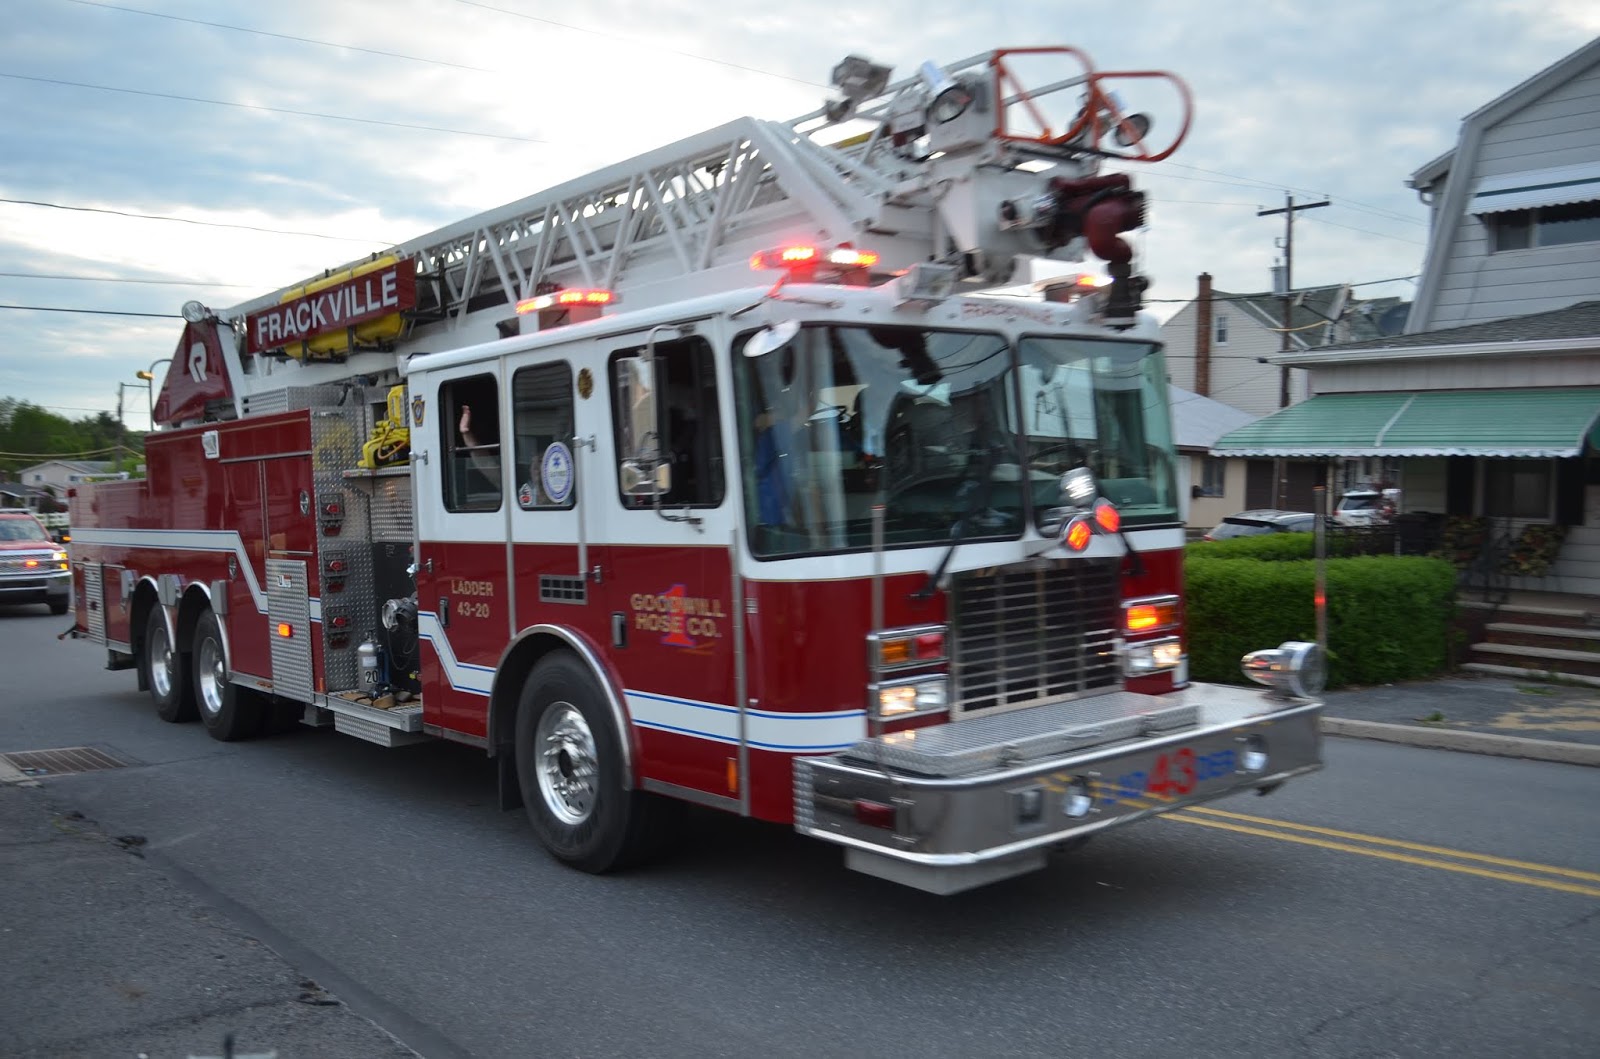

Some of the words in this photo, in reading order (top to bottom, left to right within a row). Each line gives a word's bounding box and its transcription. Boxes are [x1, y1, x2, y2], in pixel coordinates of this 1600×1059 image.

[257, 271, 399, 346] FRACKVILLE
[451, 579, 494, 597] LADDER
[457, 601, 490, 618] 43-20
[635, 613, 684, 633] HOSE
[686, 617, 722, 637] CO.
[365, 670, 378, 684] 20
[1147, 747, 1198, 796] 43
